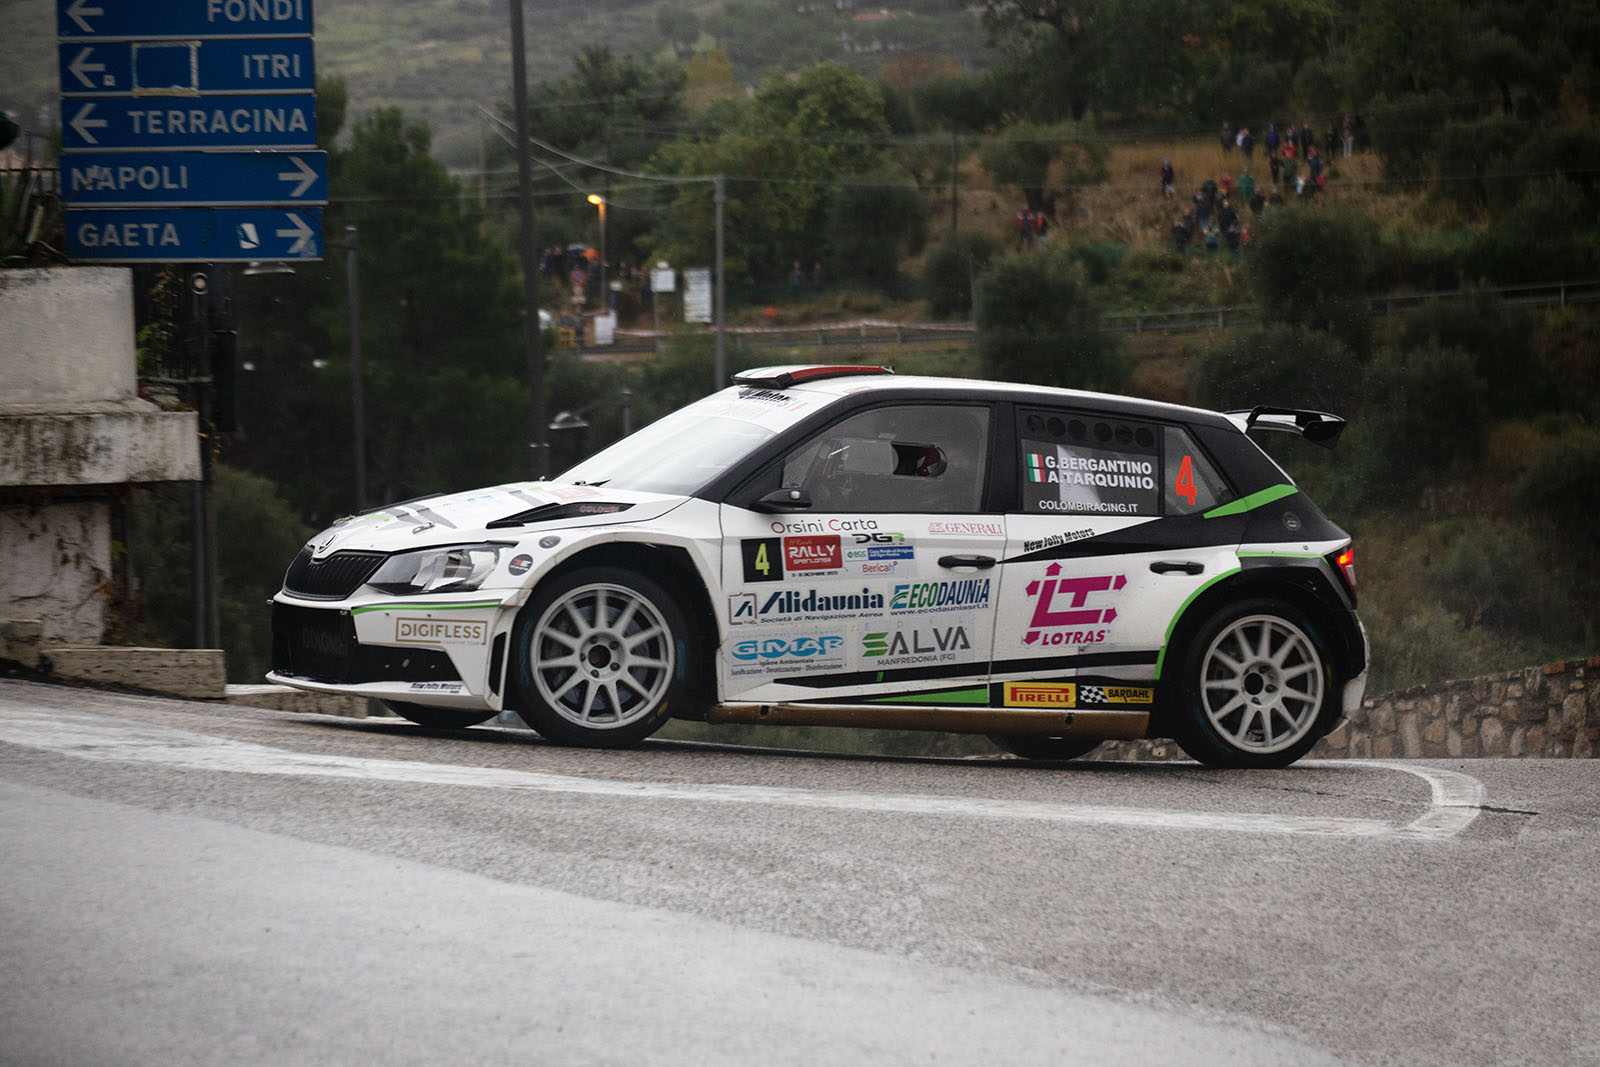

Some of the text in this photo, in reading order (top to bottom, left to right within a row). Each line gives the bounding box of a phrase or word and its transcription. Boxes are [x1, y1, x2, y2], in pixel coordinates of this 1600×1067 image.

[207, 0, 304, 22] FONDI
[243, 54, 301, 79] ITRI
[128, 109, 309, 134] TERRACINA
[71, 165, 188, 191] NAPOLI
[78, 222, 181, 247] GAETA
[1045, 456, 1152, 475] G.BERGANTINO
[1175, 455, 1197, 506] 4
[1038, 500, 1138, 513] COLOMBIRACING.IT
[770, 518, 878, 534] Orsini Carta
[945, 522, 1004, 535] GENERALI
[1024, 528, 1095, 552] New Jolly Motors
[755, 543, 770, 575] 4
[788, 544, 836, 559] RALLY
[759, 588, 883, 614] Alidaunia
[805, 613, 856, 622] Navigazione
[890, 603, 988, 616] www.ecodauniasrl.it
[401, 623, 481, 639] DIGIFLESS
[1042, 630, 1106, 646] LOTRAS
[877, 655, 938, 666] MANFREDONIA
[1010, 687, 1070, 702] PIRELLI
[1108, 689, 1150, 703] BARDAHL
